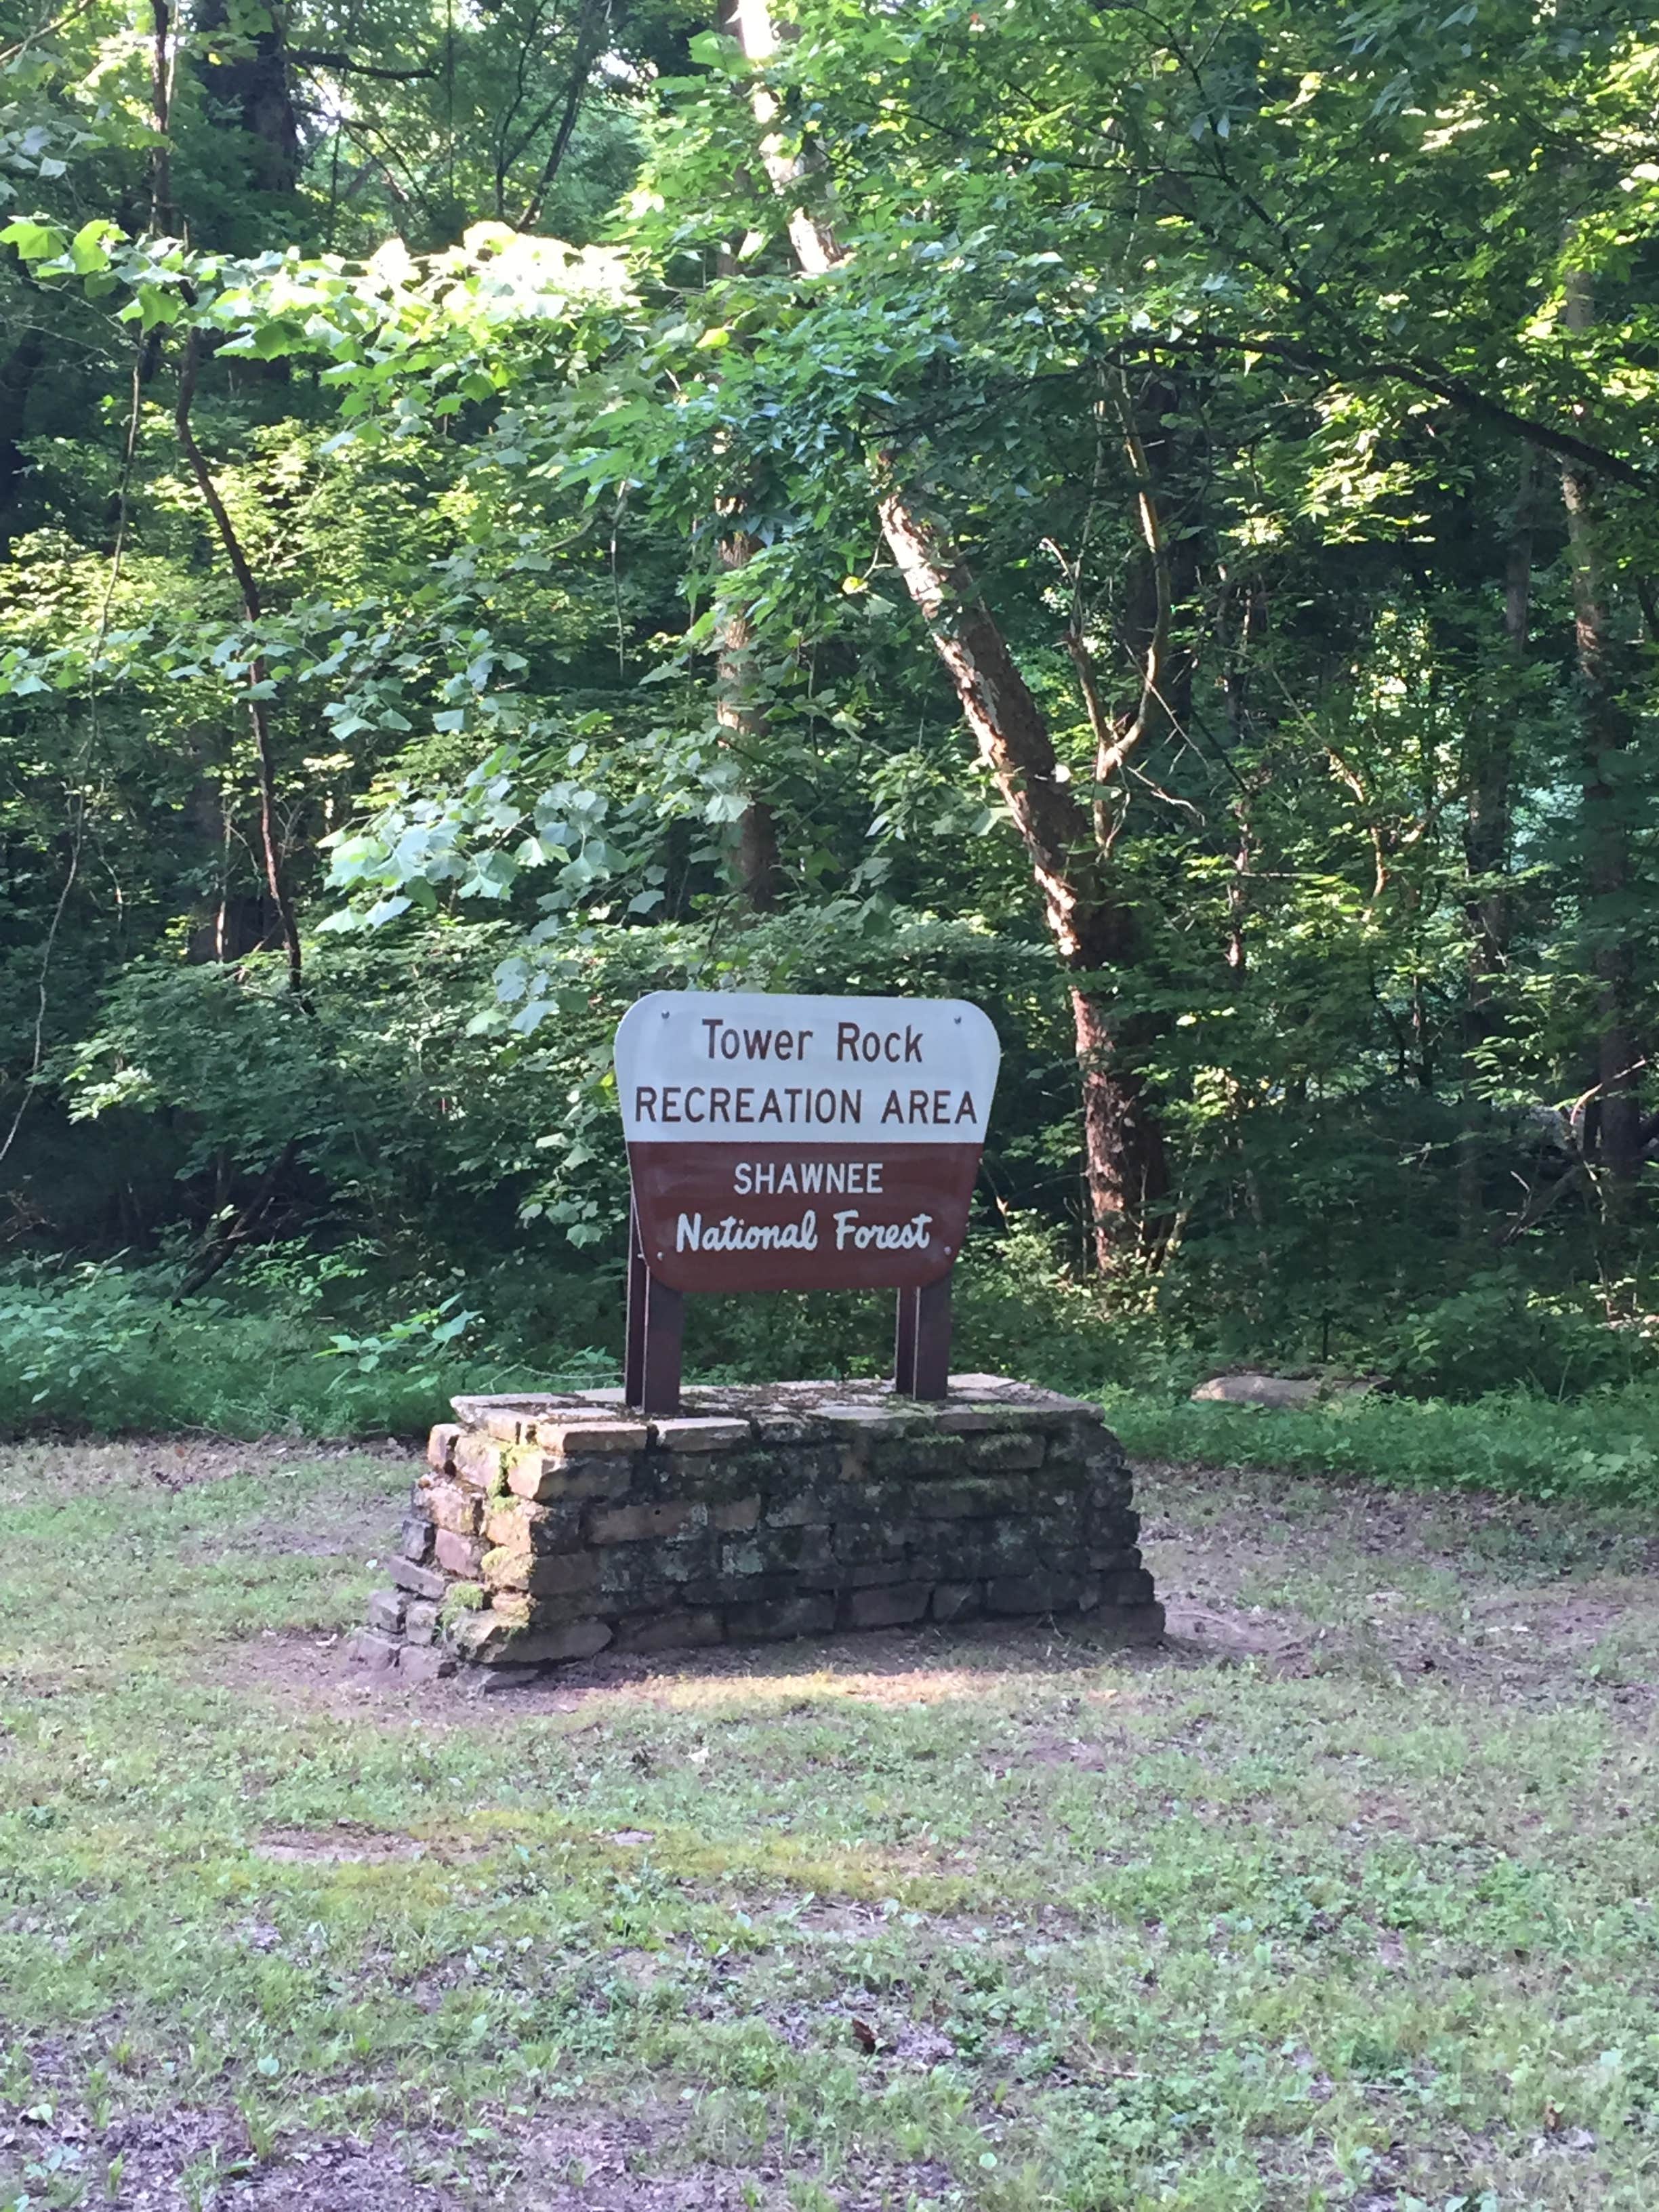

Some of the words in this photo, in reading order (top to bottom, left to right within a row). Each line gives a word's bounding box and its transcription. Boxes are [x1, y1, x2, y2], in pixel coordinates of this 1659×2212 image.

[701, 1018, 814, 1061] Tower
[836, 1021, 924, 1063] Rock
[635, 1086, 862, 1124] RECREATION
[880, 1089, 978, 1125] AREA
[733, 1163, 883, 1194] SHAWNEE
[676, 1210, 817, 1252] National
[833, 1210, 933, 1250] Forest
